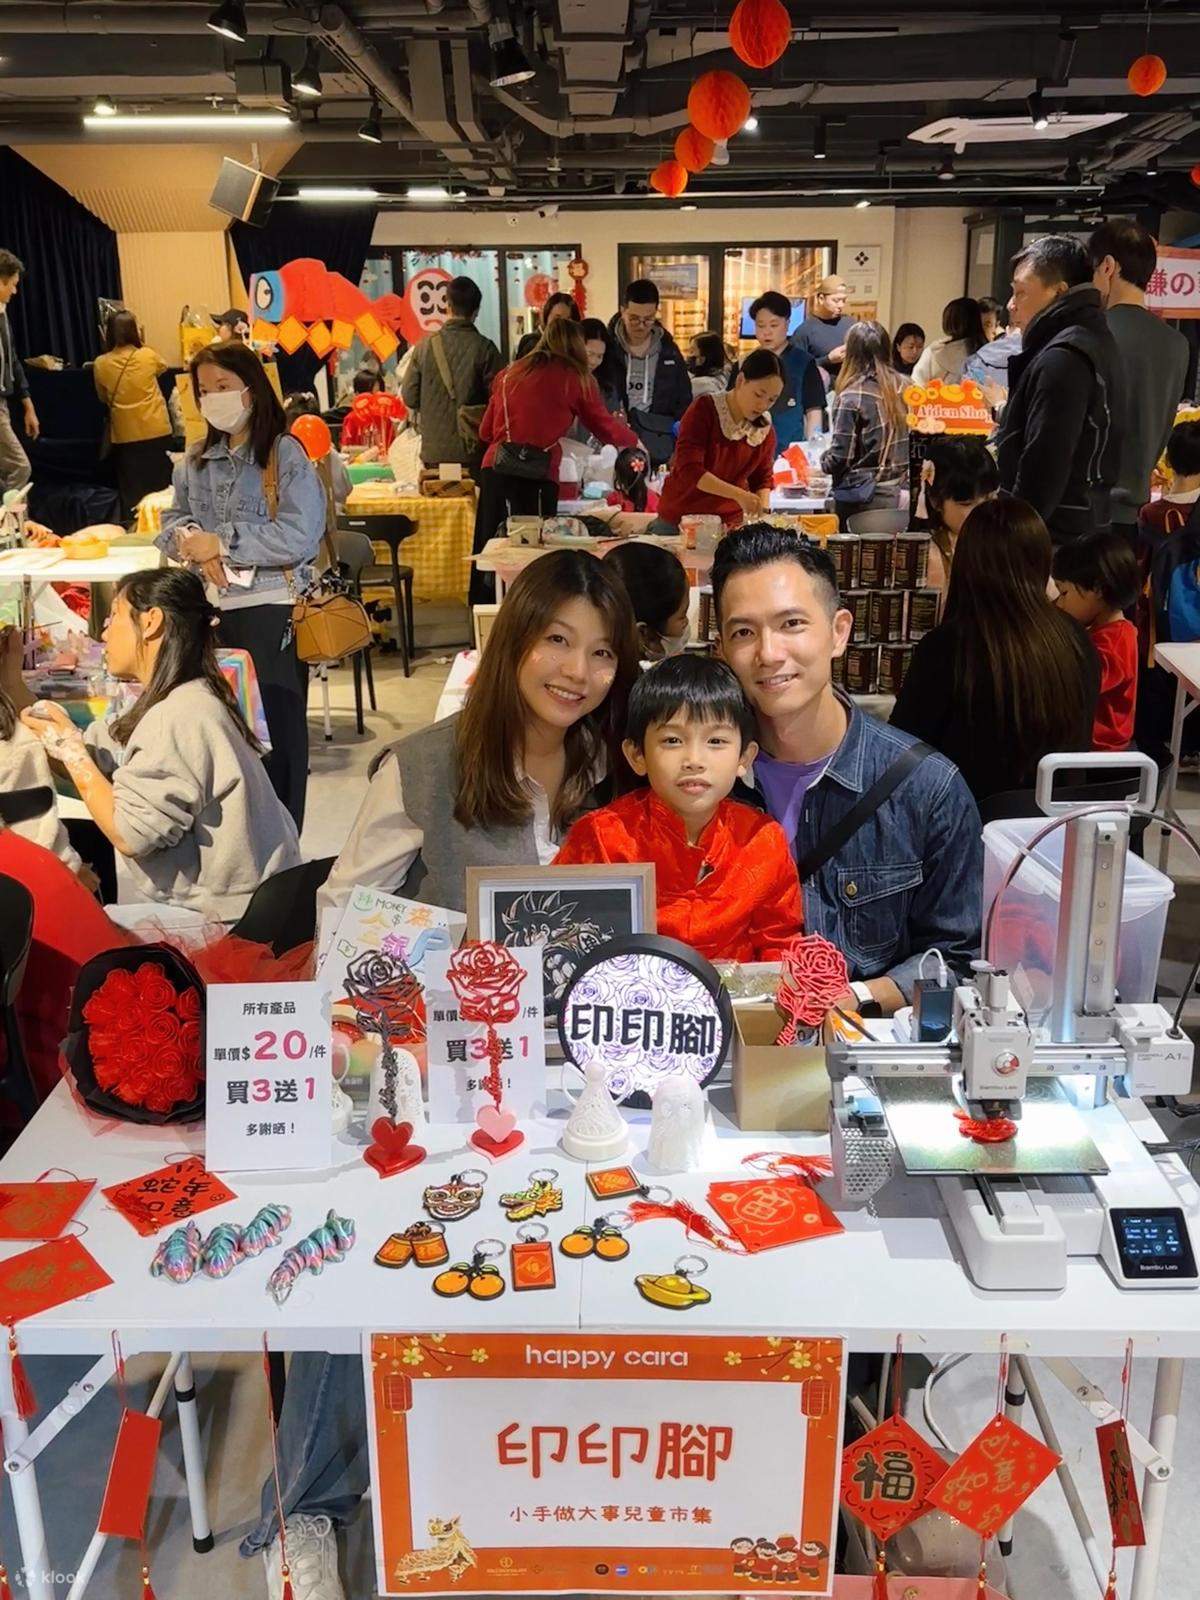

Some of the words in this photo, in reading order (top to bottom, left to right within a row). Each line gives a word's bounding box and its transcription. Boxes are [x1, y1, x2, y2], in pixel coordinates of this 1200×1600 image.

[917, 404, 958, 418] Aiden
[242, 1001, 296, 1015] 所有產品
[571, 1003, 716, 1057] 印印腳
[526, 1345, 615, 1369] happy
[624, 1350, 689, 1366] cara
[498, 1422, 733, 1481] 印印腳
[853, 1451, 915, 1501] 福
[510, 1504, 713, 1524] 小手做大事兒童市集
